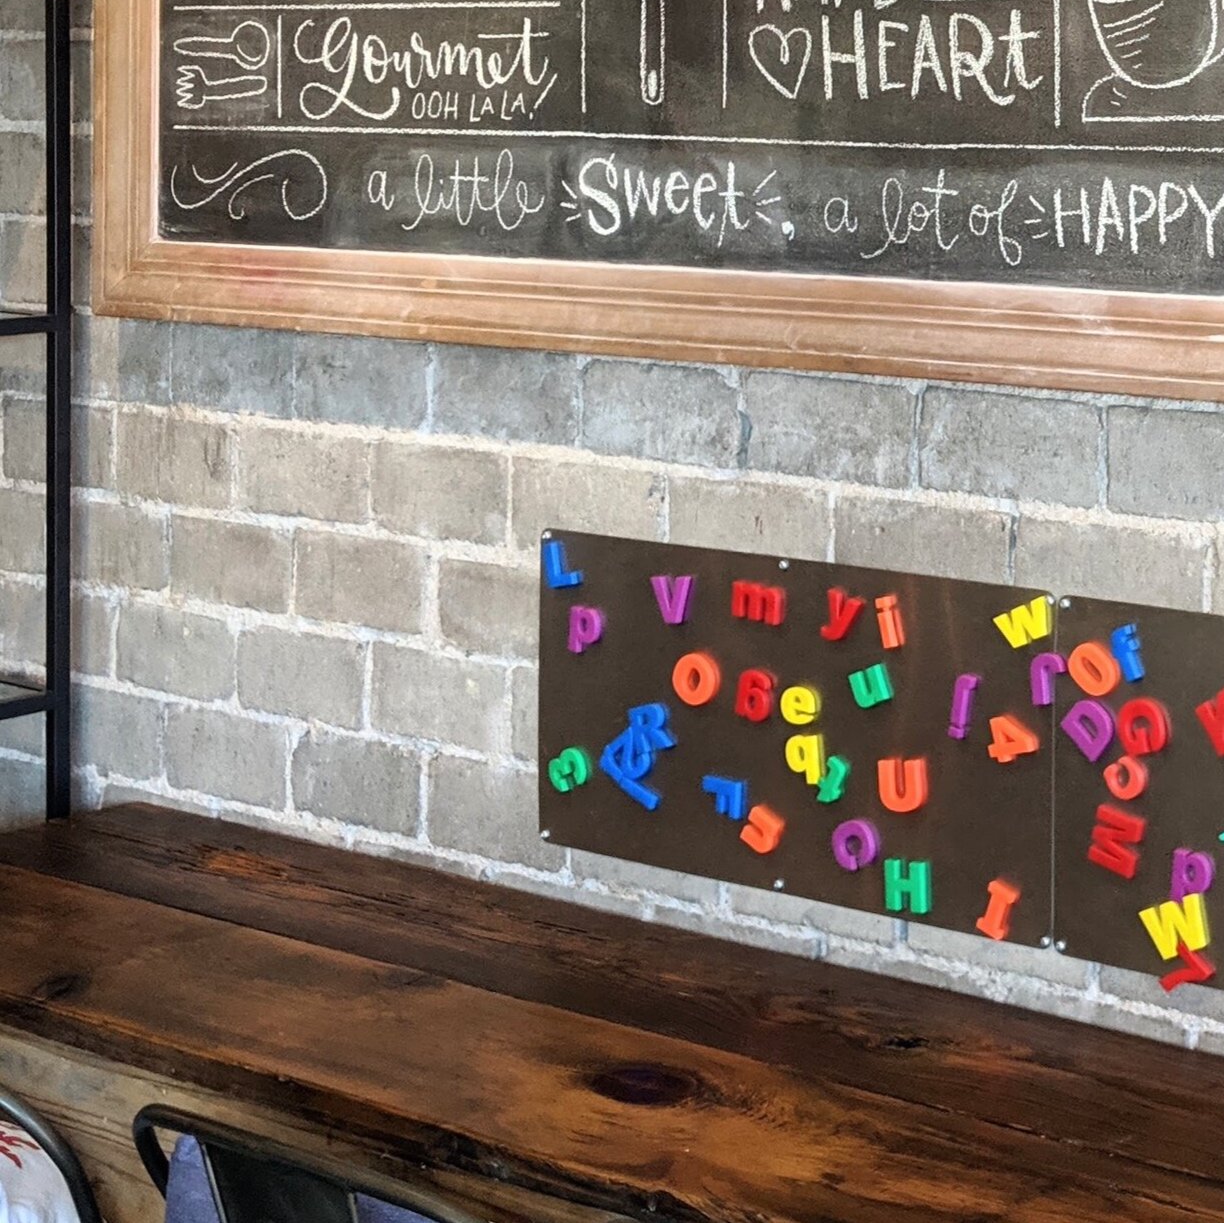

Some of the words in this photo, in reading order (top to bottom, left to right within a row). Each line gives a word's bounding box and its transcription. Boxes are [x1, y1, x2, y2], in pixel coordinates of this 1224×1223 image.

[293, 16, 551, 121] Gourmet
[411, 91, 459, 120] OOH
[470, 93, 495, 122] LA
[368, 169, 395, 210] a
[401, 148, 545, 231] little
[824, 196, 859, 233] a
[860, 168, 960, 260] lot
[968, 179, 1022, 266] of
